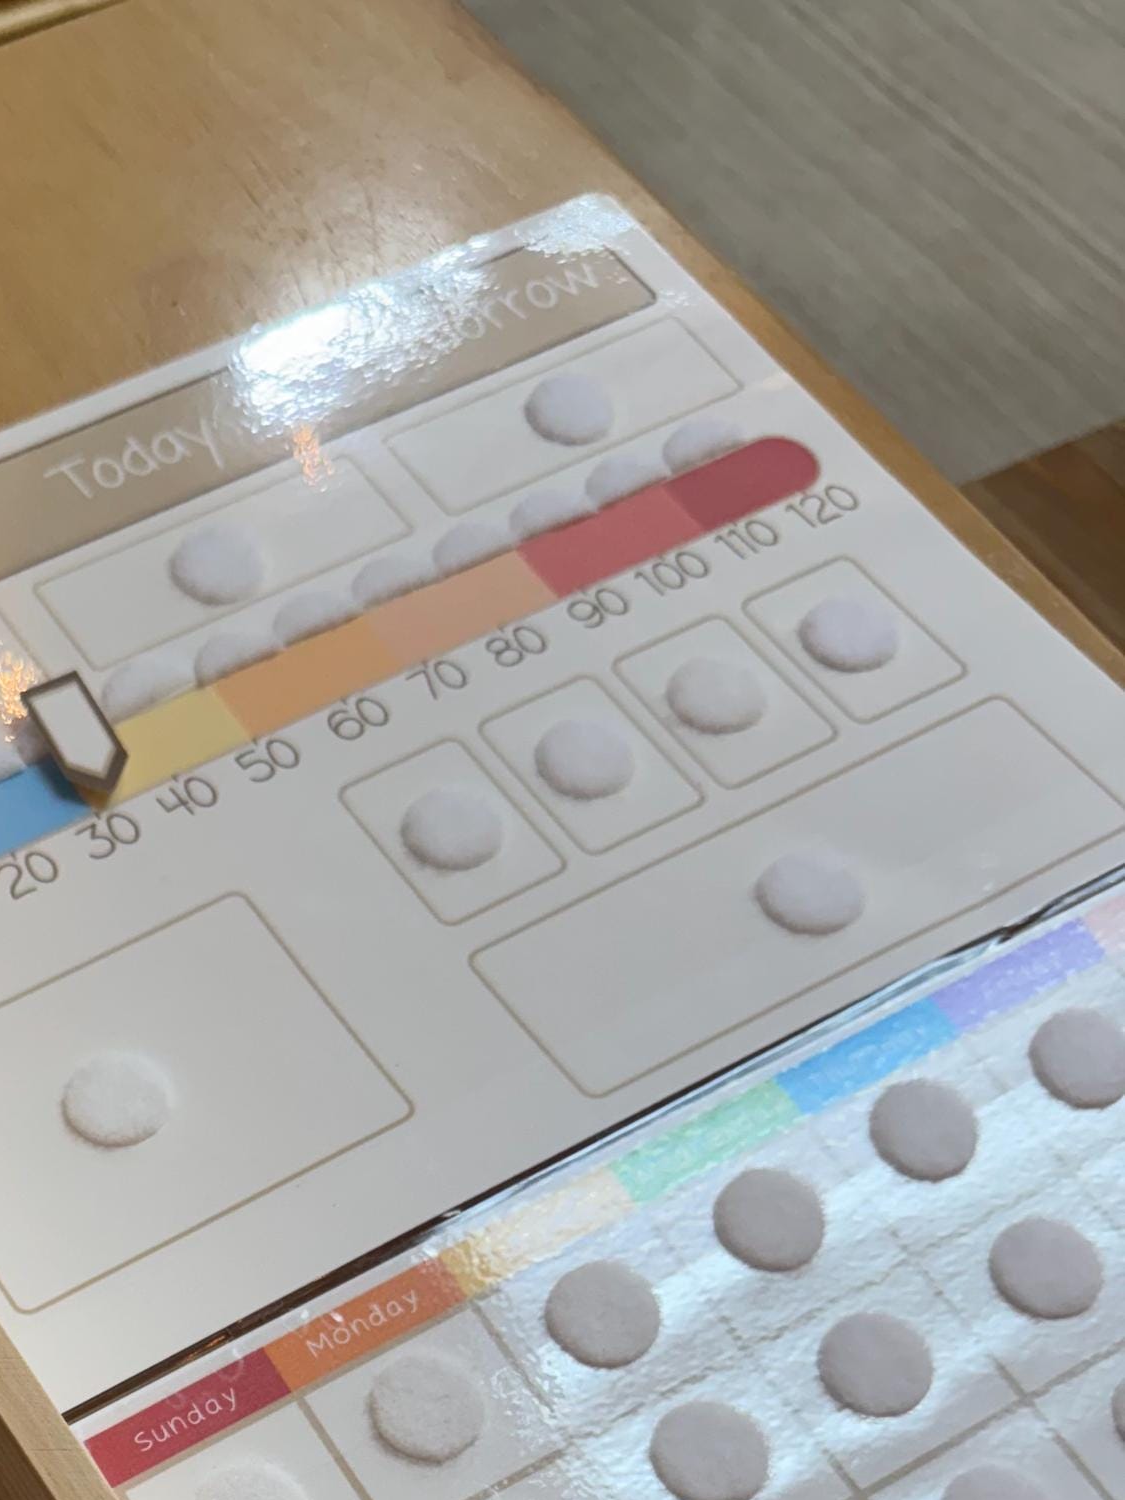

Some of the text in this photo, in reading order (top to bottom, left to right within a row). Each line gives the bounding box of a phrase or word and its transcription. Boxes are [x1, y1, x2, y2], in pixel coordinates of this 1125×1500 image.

[42, 415, 225, 499] Today
[76, 812, 141, 860] 30
[156, 774, 219, 816] 40
[234, 737, 301, 783] 50
[326, 696, 390, 741] 60
[405, 660, 469, 701] 70
[485, 624, 548, 668] 80
[567, 587, 630, 629] 90
[634, 551, 712, 597] 100
[714, 519, 780, 561] 110
[785, 484, 860, 529] 120
[134, 1288, 421, 1453] Sunday Monday
